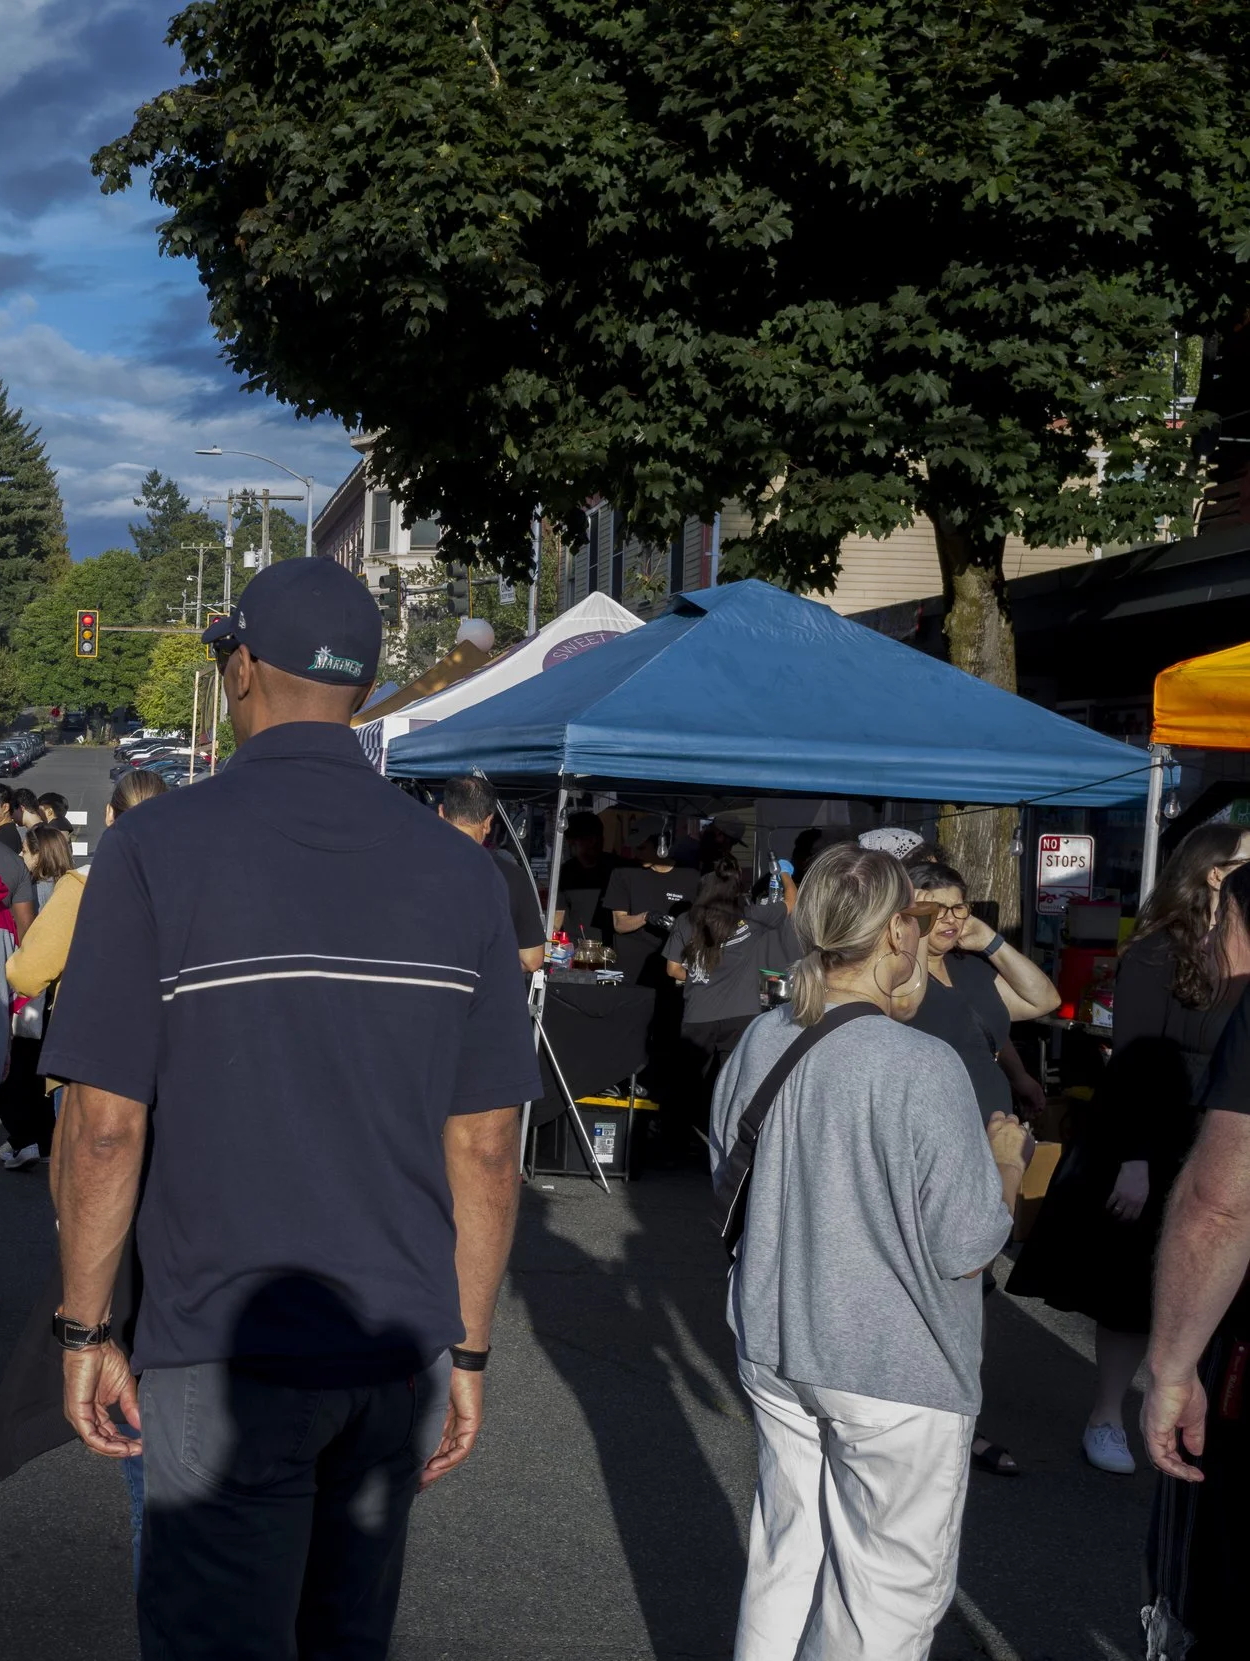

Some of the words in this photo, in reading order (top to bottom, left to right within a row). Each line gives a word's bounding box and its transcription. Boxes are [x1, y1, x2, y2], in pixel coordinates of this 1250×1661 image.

[552, 633, 607, 660] SWEET
[1043, 838, 1058, 850] NO
[1046, 854, 1086, 868] STOPS
